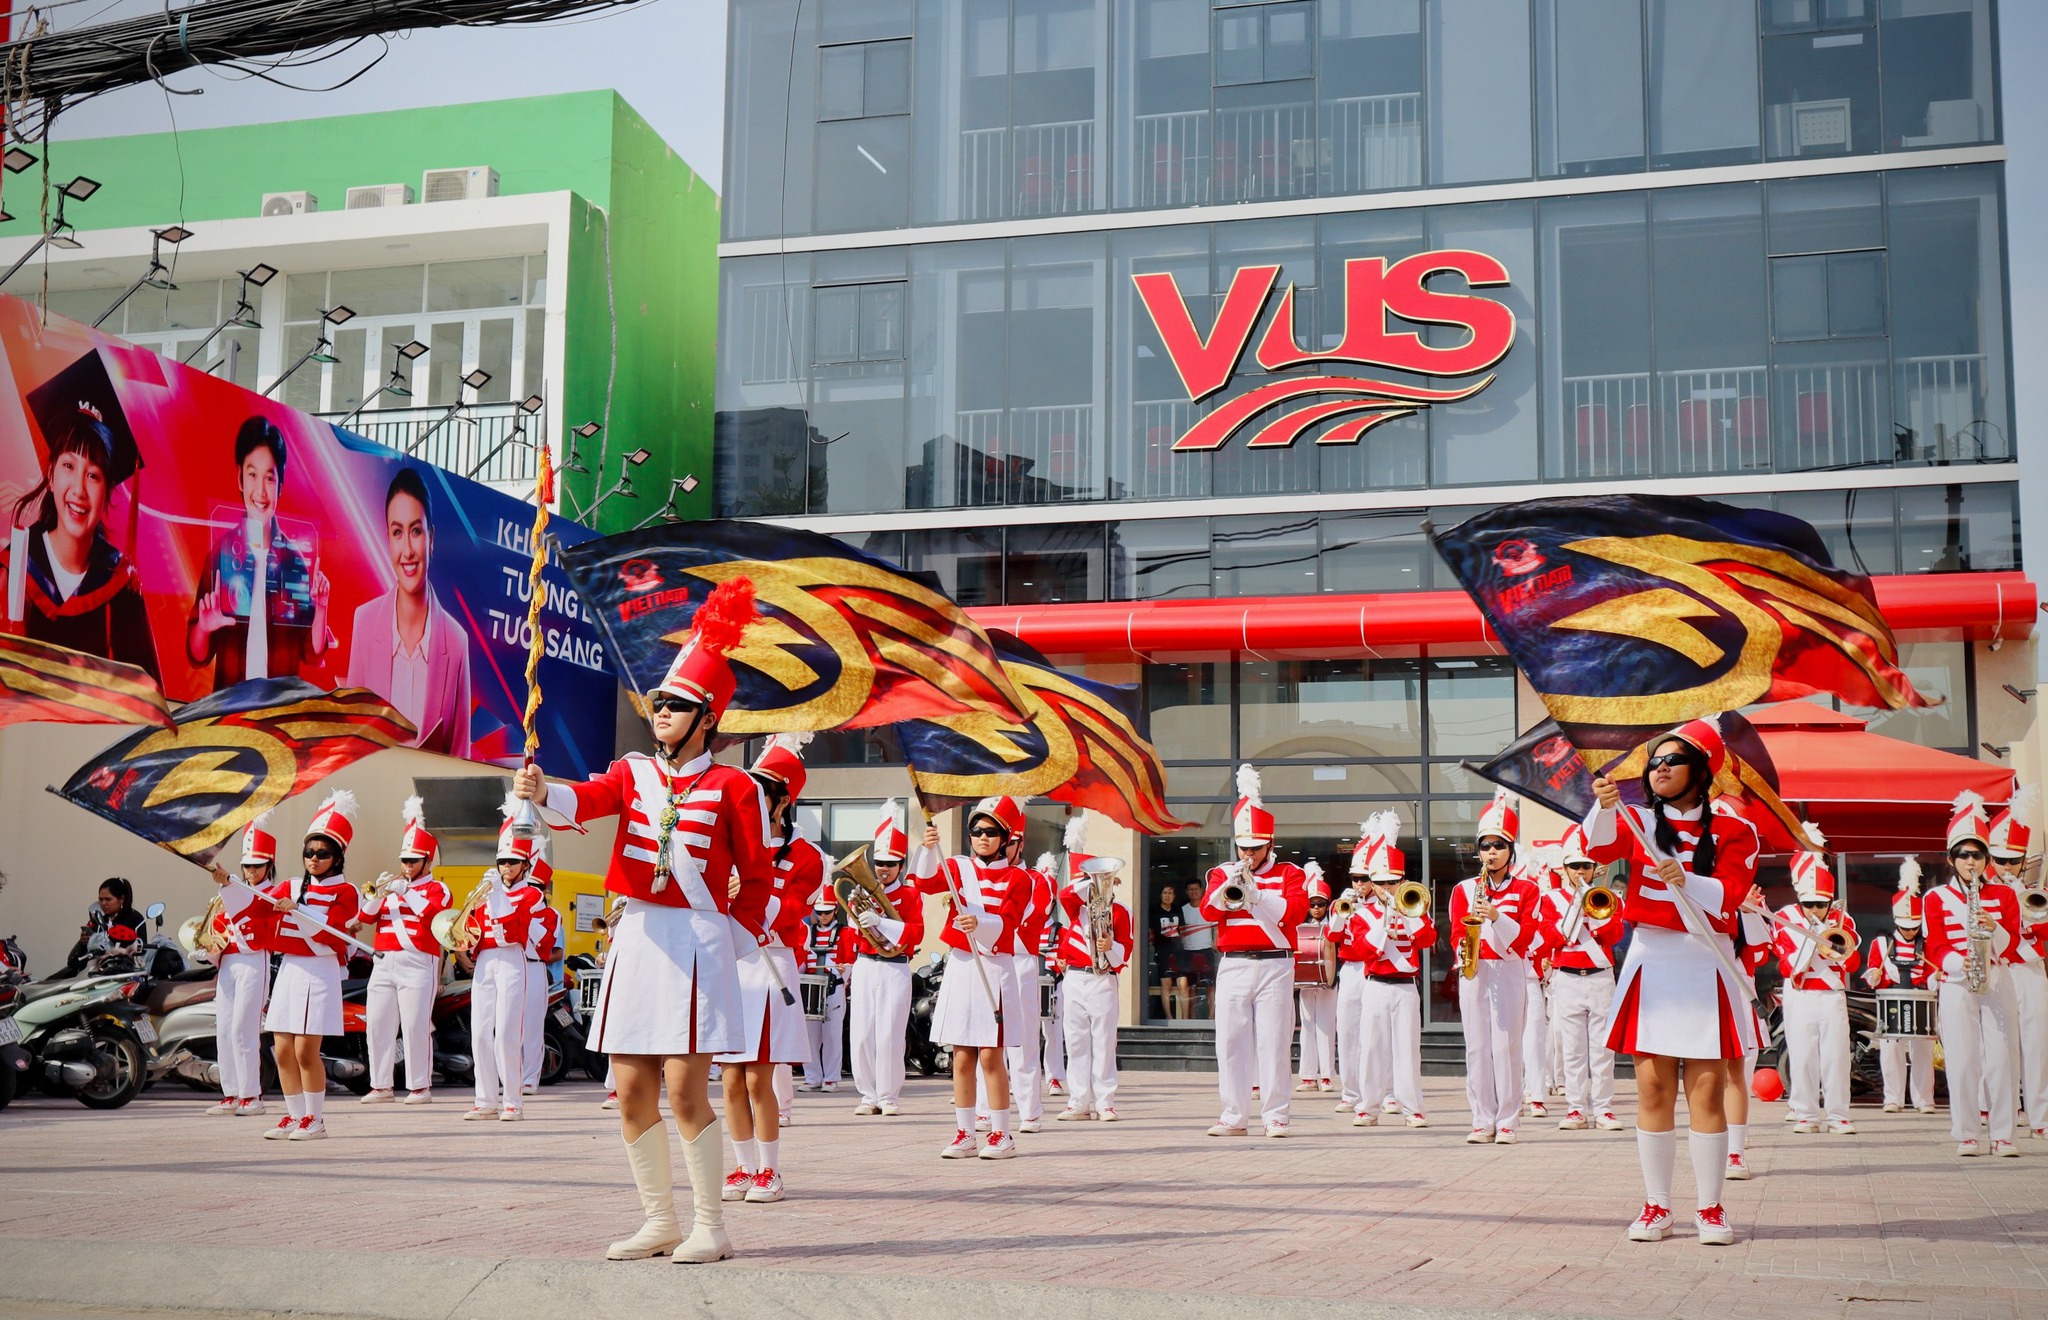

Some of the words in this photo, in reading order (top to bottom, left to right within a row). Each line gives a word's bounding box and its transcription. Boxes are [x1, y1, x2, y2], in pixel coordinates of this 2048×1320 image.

[1130, 249, 1516, 403] VUS
[617, 586, 690, 624] VIETNAM
[545, 626, 604, 671] SÁNG
